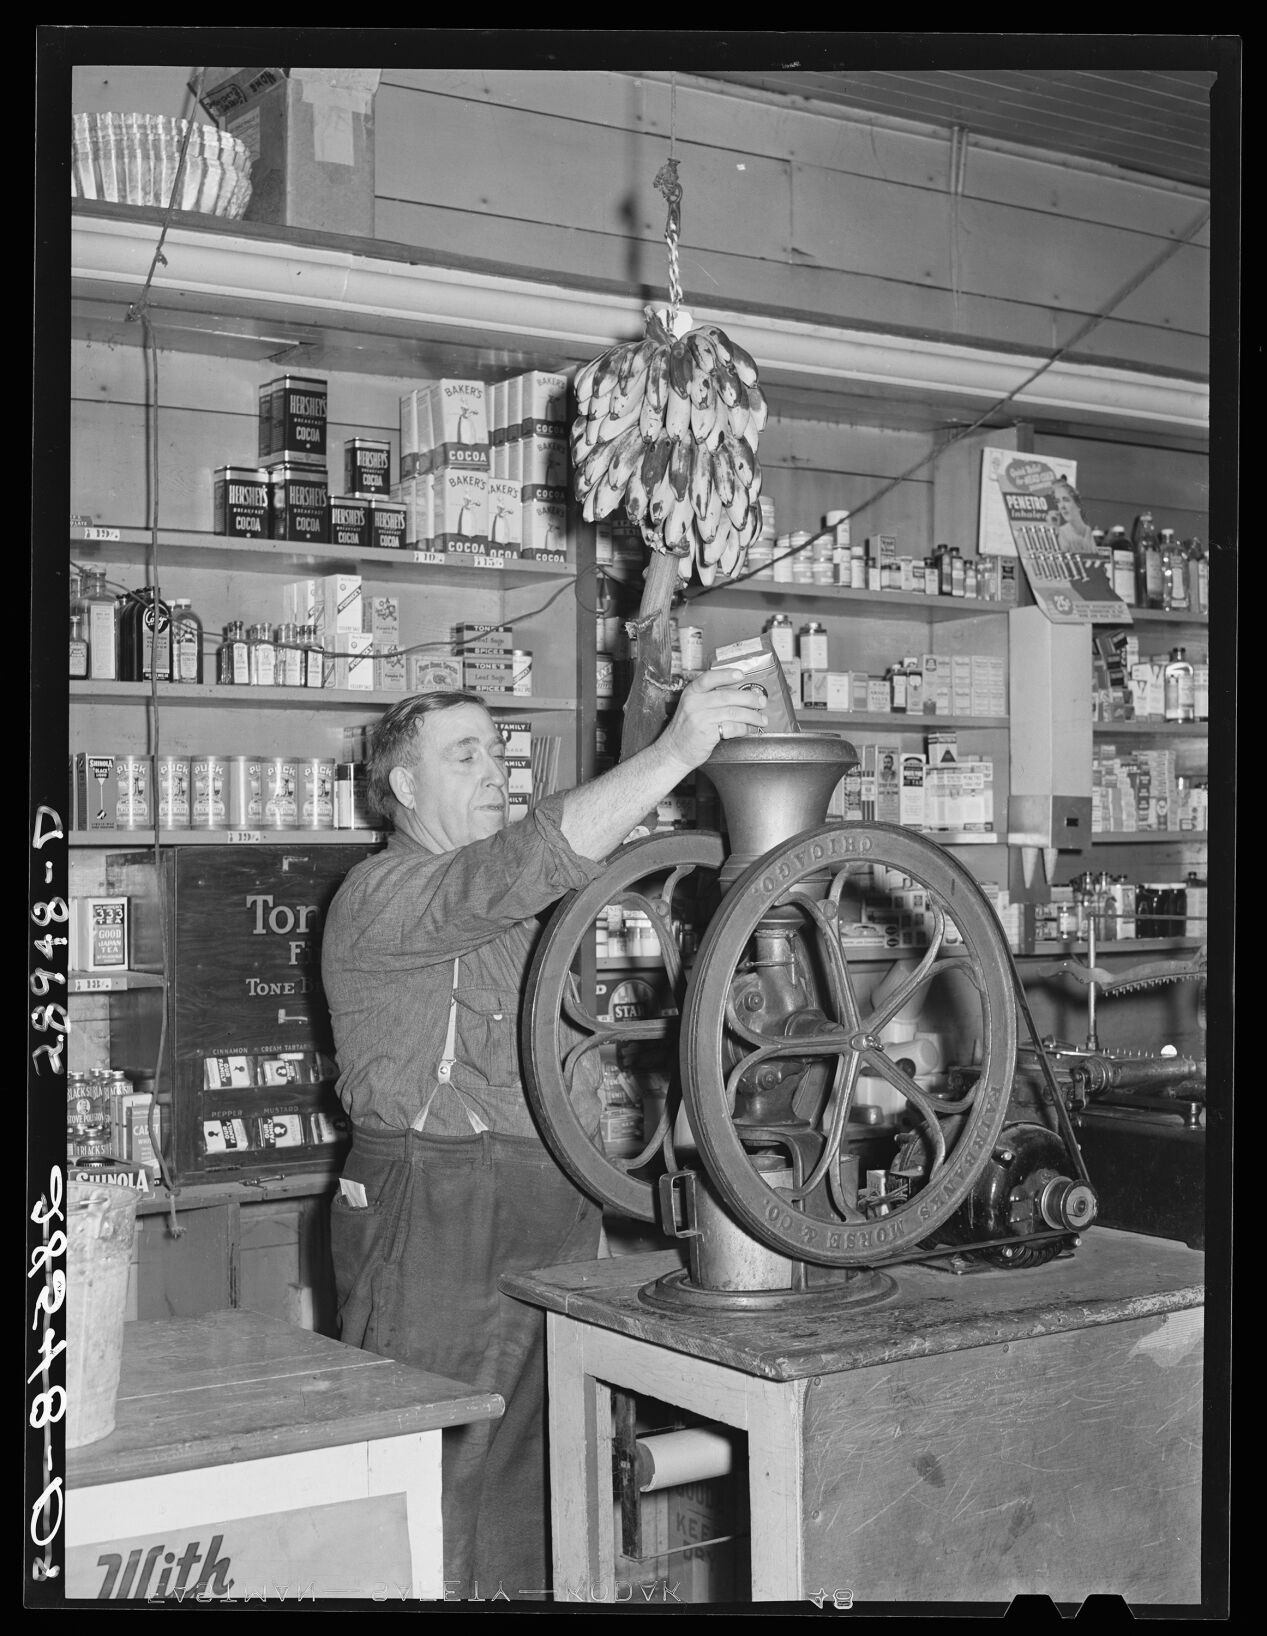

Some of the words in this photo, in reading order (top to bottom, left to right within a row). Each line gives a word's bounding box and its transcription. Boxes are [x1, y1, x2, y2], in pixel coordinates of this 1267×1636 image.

[536, 377, 566, 390] BAKER'S
[444, 384, 484, 399] BAKER'S
[290, 394, 327, 418] HERSHEY'S
[296, 426, 320, 442] COCOA
[357, 450, 388, 469] HERSHEY'S
[449, 450, 487, 462] COCOA
[362, 474, 383, 486] COCOA
[448, 475, 487, 490] BAKER'S
[229, 484, 268, 507] HERSHEY'S
[289, 485, 327, 508] HERSHEY'S
[488, 484, 519, 499] AKER'S
[1006, 495, 1048, 511] PENETRO
[332, 507, 365, 526] HERSHEY'S
[374, 511, 406, 530] HERSHEY'S
[1011, 509, 1048, 519] Inhaler
[235, 516, 261, 532] COCOA
[296, 517, 320, 532] COCOA
[338, 532, 359, 544] COCOA
[380, 535, 399, 547] COCOA
[448, 541, 486, 554] COCOA
[490, 549, 519, 560] OCOA
[535, 553, 565, 563] COCOA
[89, 759, 113, 769] SHINOLA
[116, 763, 146, 776] PUCK
[194, 763, 224, 775] PUCK
[96, 909, 123, 919] 333
[98, 929, 121, 939] GOOD
[246, 977, 295, 997] TONE
[212, 1047, 248, 1056] CINNAMON
[261, 1045, 282, 1053] CREAM
[217, 1058, 227, 1083] FAMILY
[223, 1063, 231, 1078] OUR
[211, 1109, 243, 1118] PEPPER
[263, 1106, 299, 1114] MUSTARD
[222, 1126, 230, 1140] OUR
[226, 1121, 236, 1144] FAMILY
[267, 1118, 275, 1145] FAMILY
[826, 1219, 905, 1250] MORSE
[96, 1534, 235, 1599] With
